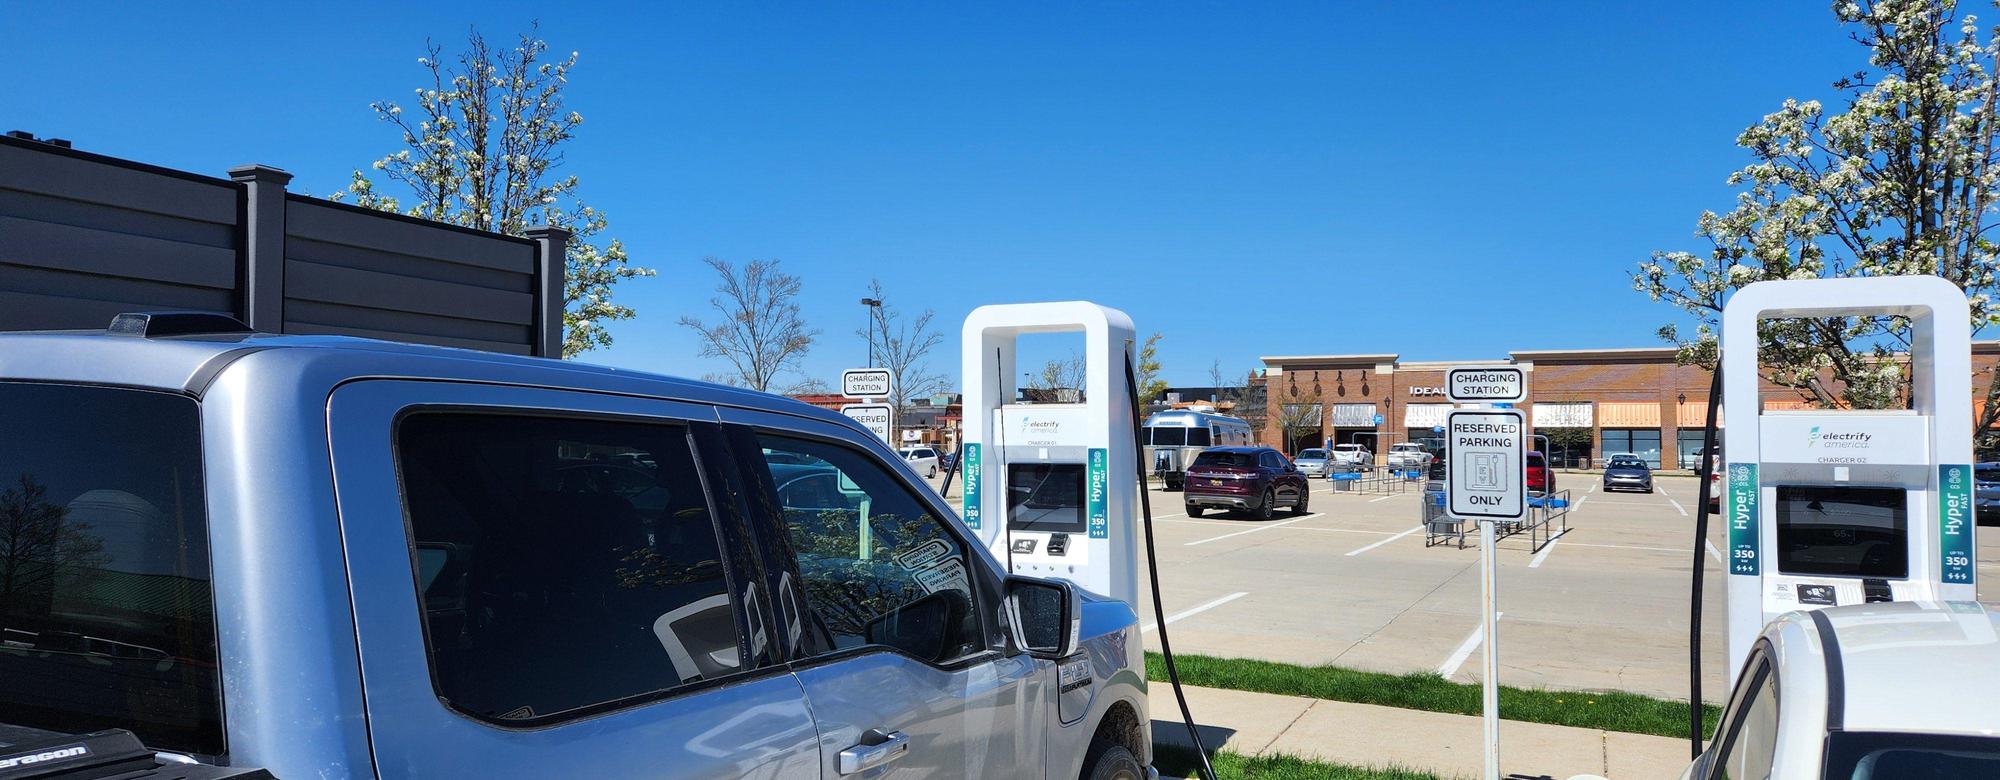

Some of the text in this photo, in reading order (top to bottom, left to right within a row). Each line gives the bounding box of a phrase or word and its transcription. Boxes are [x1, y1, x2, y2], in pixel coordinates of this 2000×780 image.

[1456, 374, 1516, 383] CHARGING
[1463, 386, 1509, 394] STATION
[851, 415, 886, 423] ESERVED
[1030, 420, 1059, 428] electrify
[1454, 423, 1517, 434] RESERVED
[1822, 432, 1872, 441] electrify
[1460, 438, 1512, 448] PARKING
[966, 464, 976, 495] Hyper
[1091, 469, 1102, 502] Hyper
[1469, 495, 1503, 505] ONLY
[1960, 493, 1968, 509] FAST
[966, 509, 979, 517] 350
[1734, 490, 1750, 529] Hyper
[1945, 492, 1962, 535] Hyper
[1091, 518, 1105, 526] 350
[1734, 549, 1754, 559] 350
[1945, 556, 1968, 566] 350
